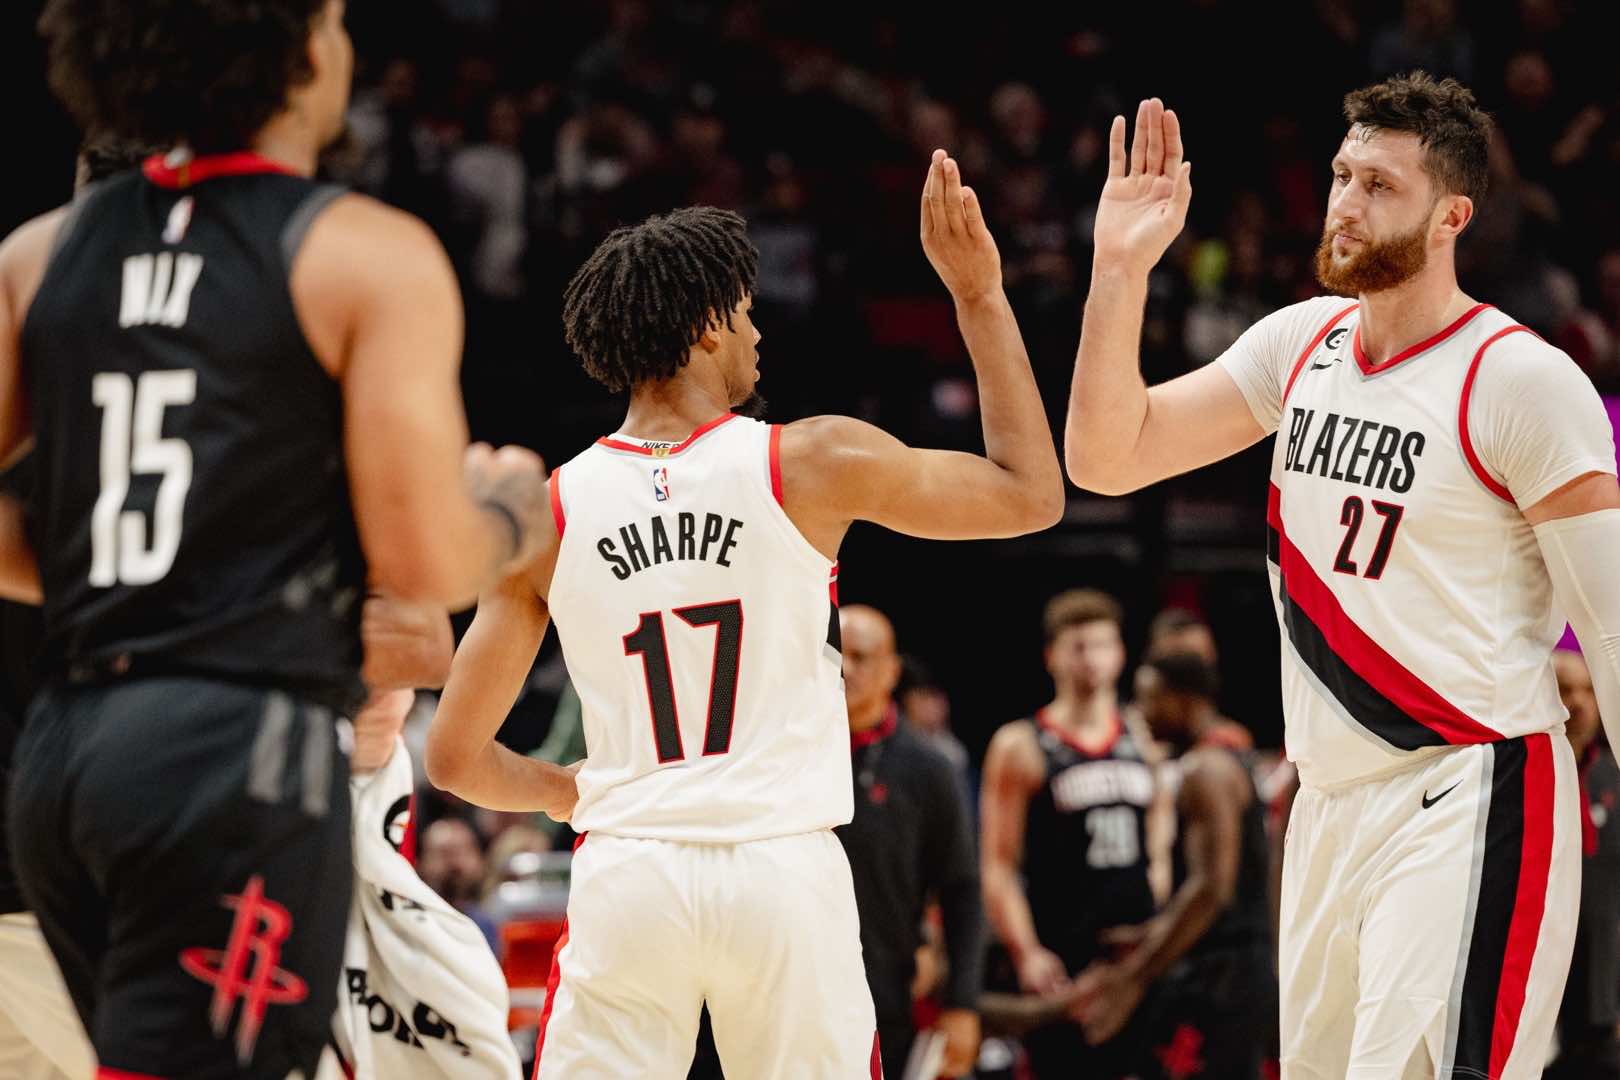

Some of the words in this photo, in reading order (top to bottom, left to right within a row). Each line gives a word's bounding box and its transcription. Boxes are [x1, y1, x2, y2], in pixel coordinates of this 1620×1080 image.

[89, 369, 198, 588] 15
[1284, 407, 1426, 494] BLAZERS
[597, 512, 744, 580] SHARPE
[1333, 495, 1405, 580] 27
[622, 599, 744, 764] 17
